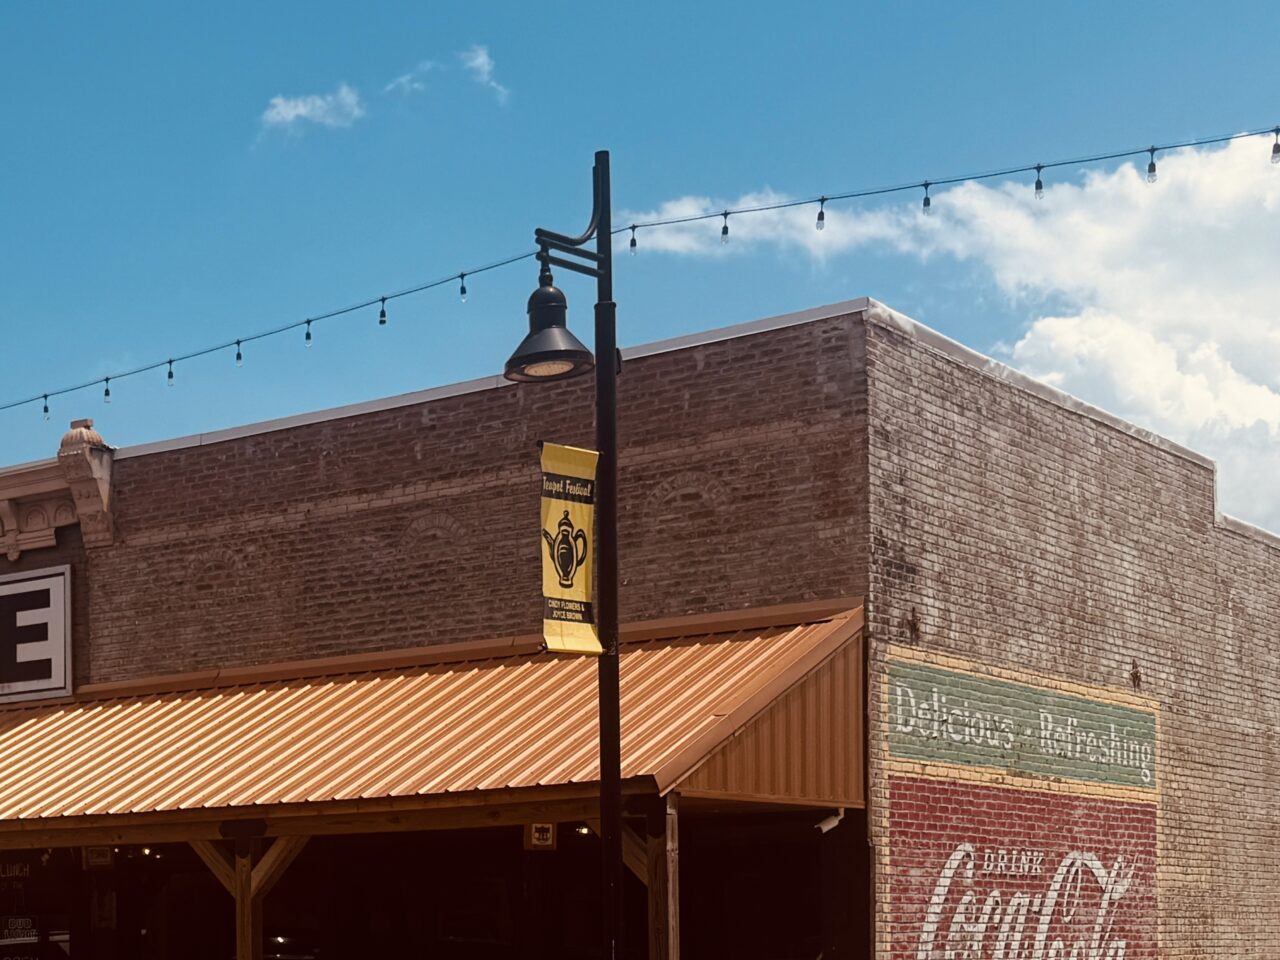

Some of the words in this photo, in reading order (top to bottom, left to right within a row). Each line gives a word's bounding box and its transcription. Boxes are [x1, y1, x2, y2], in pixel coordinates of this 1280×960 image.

[543, 476, 563, 493] Teapot
[565, 480, 591, 497] Festival
[895, 683, 1014, 749] Delicious
[1038, 708, 1151, 781] Refreshing
[983, 849, 1045, 874] DRINK
